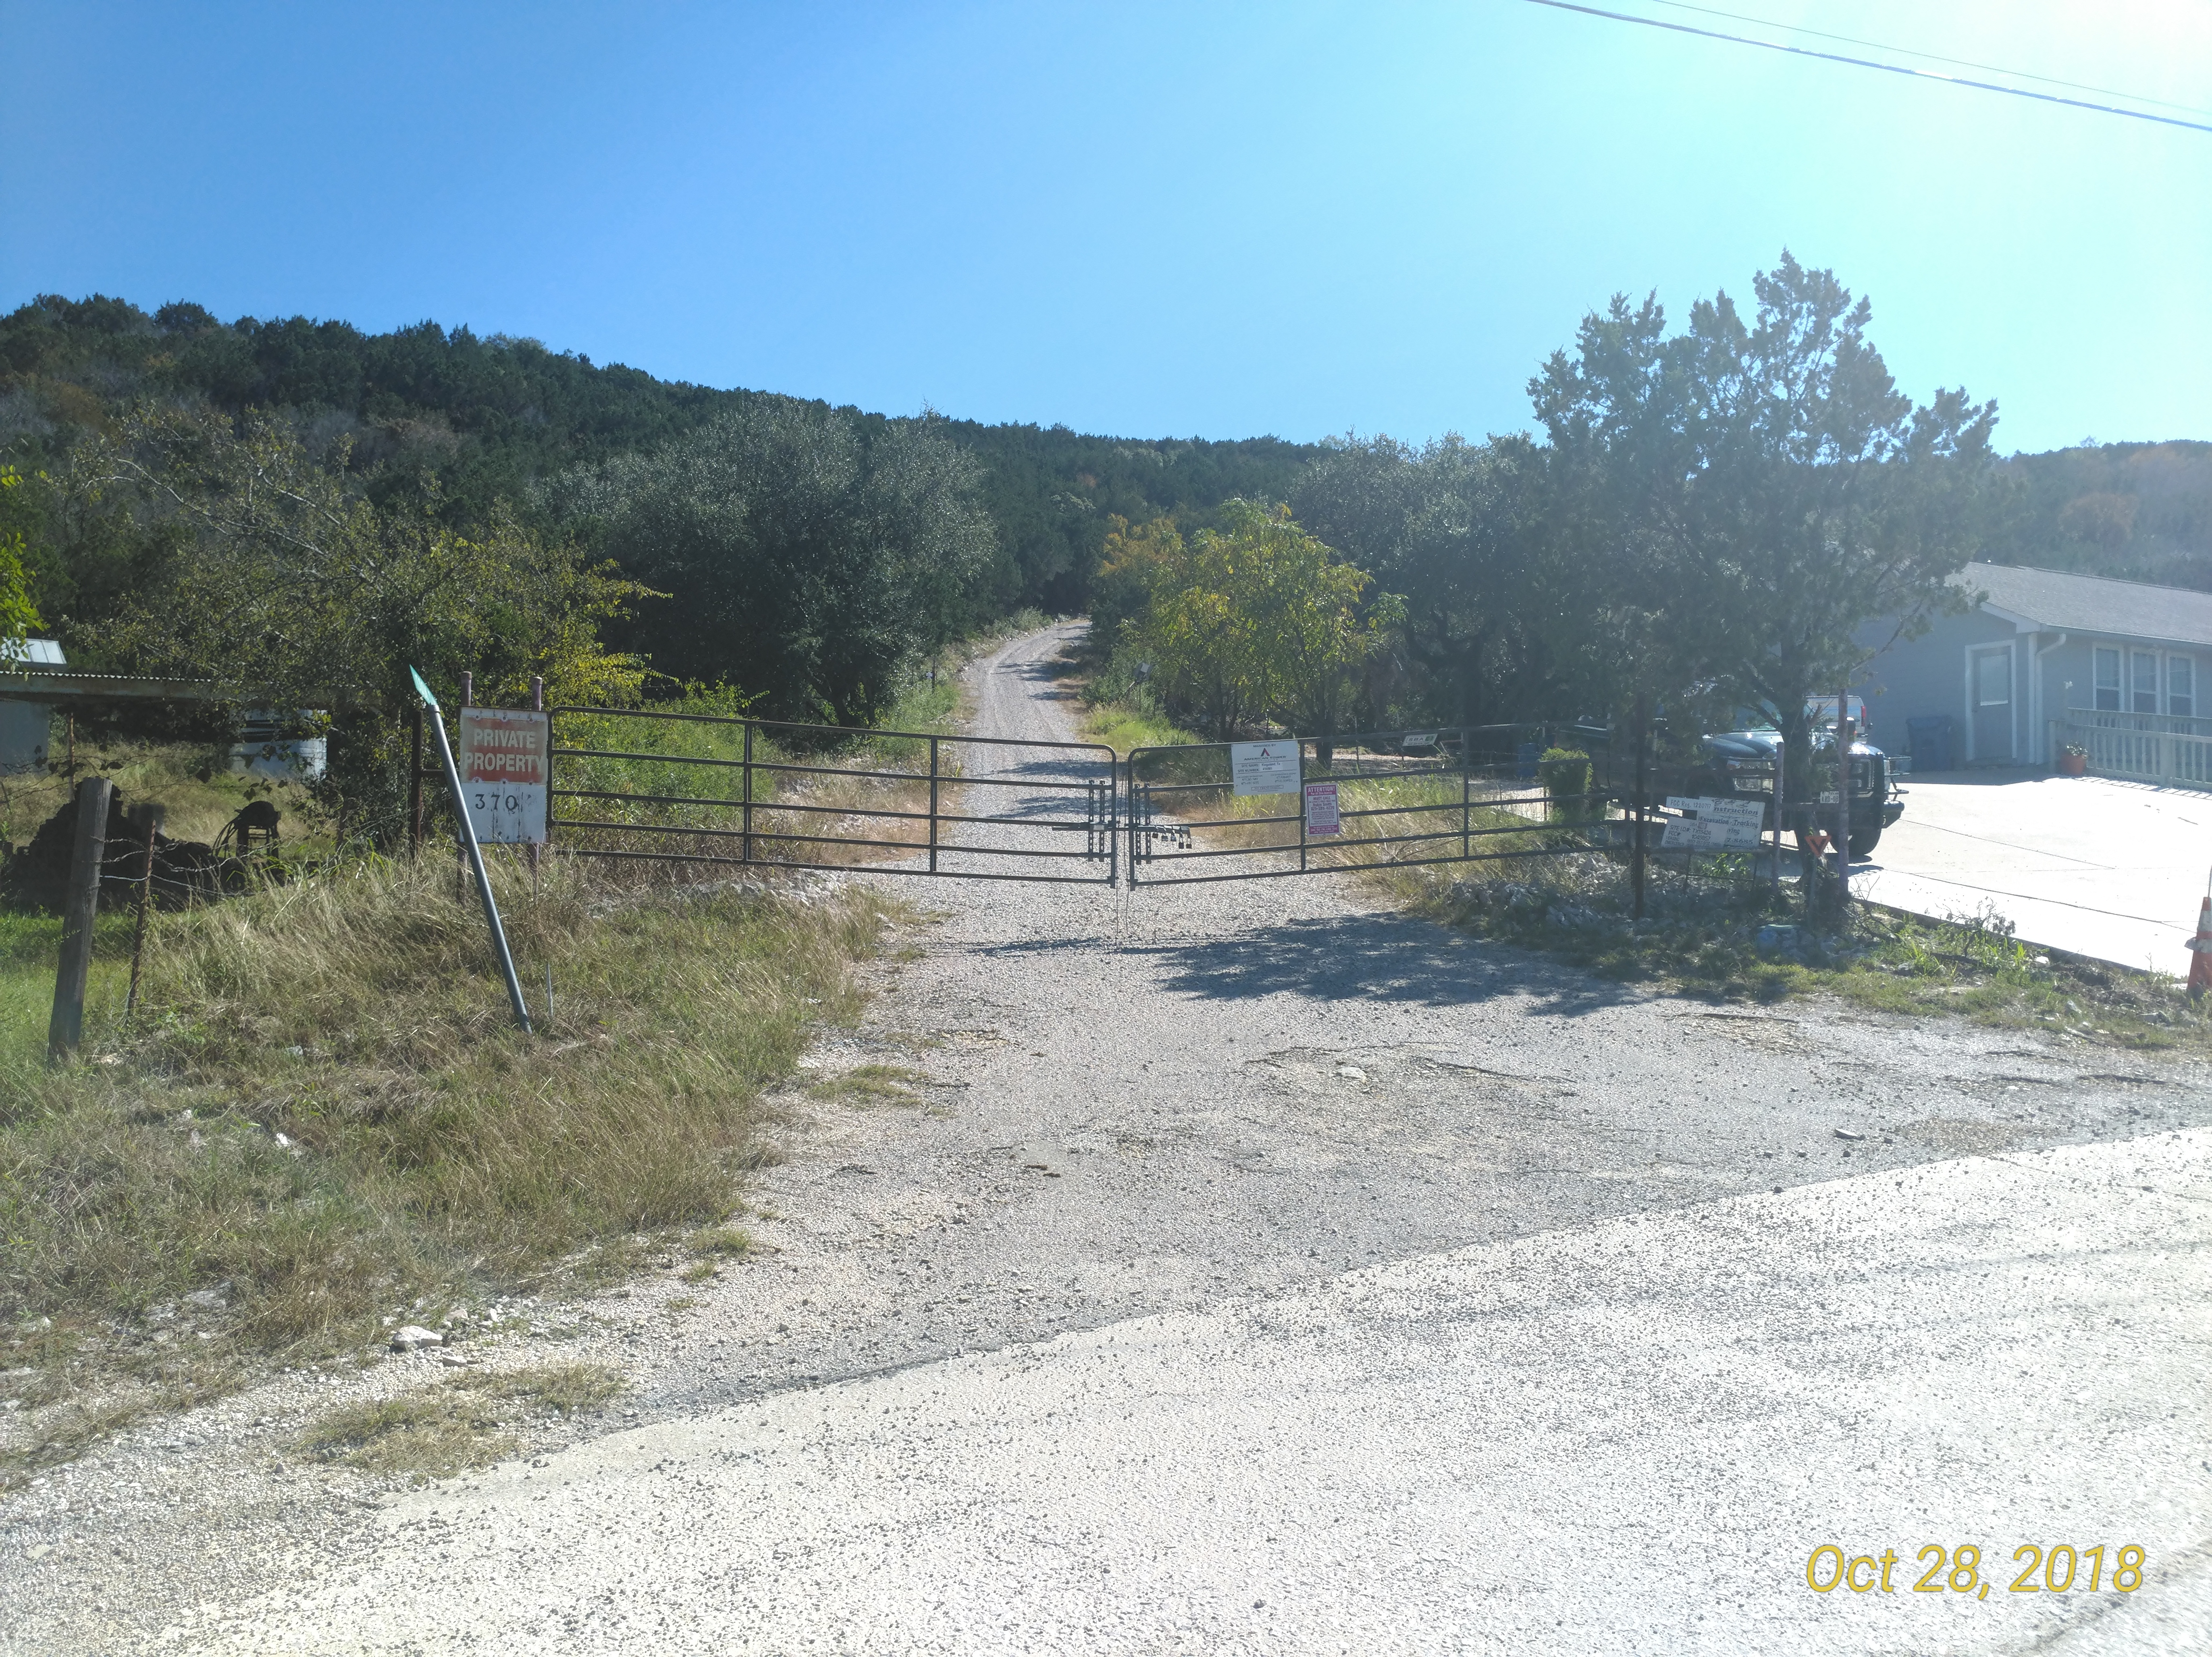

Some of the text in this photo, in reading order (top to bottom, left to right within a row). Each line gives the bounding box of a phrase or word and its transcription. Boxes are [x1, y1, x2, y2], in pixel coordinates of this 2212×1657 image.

[474, 729, 536, 748] PRIVATE
[464, 752, 543, 772] PROPERTY
[1714, 806, 1758, 815] nstruction
